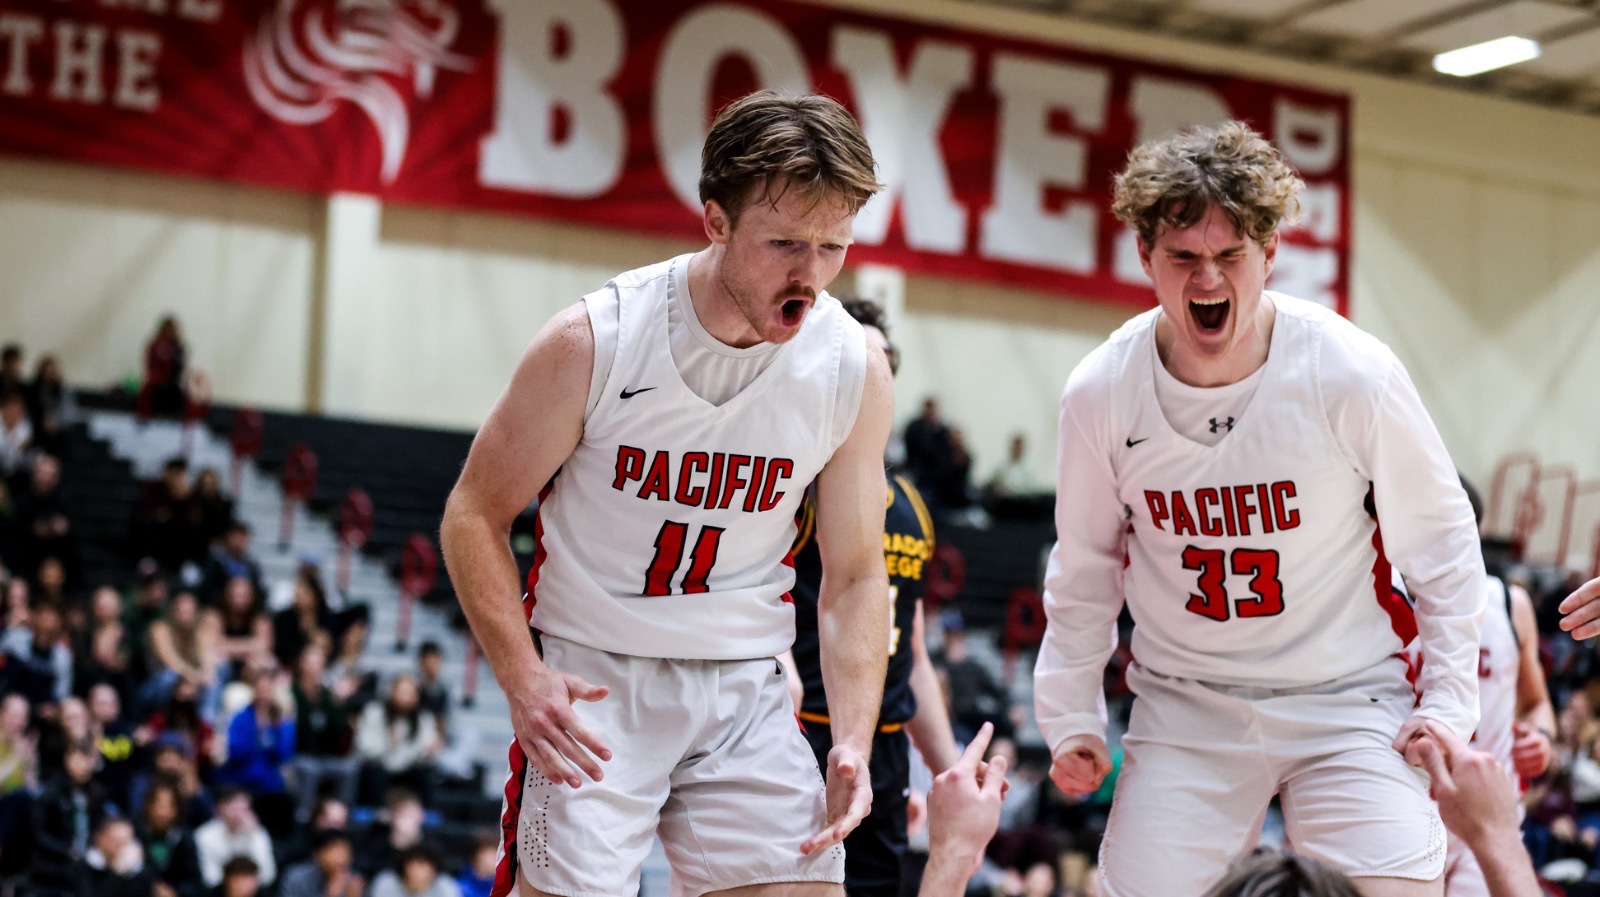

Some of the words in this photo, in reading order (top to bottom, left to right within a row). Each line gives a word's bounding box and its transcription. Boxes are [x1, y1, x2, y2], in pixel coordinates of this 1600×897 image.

[0, 14, 162, 112] THE
[612, 444, 794, 513] PACIFIC
[1143, 480, 1301, 537] PACIFIC
[642, 519, 726, 597] 11
[1181, 544, 1285, 622] 33
